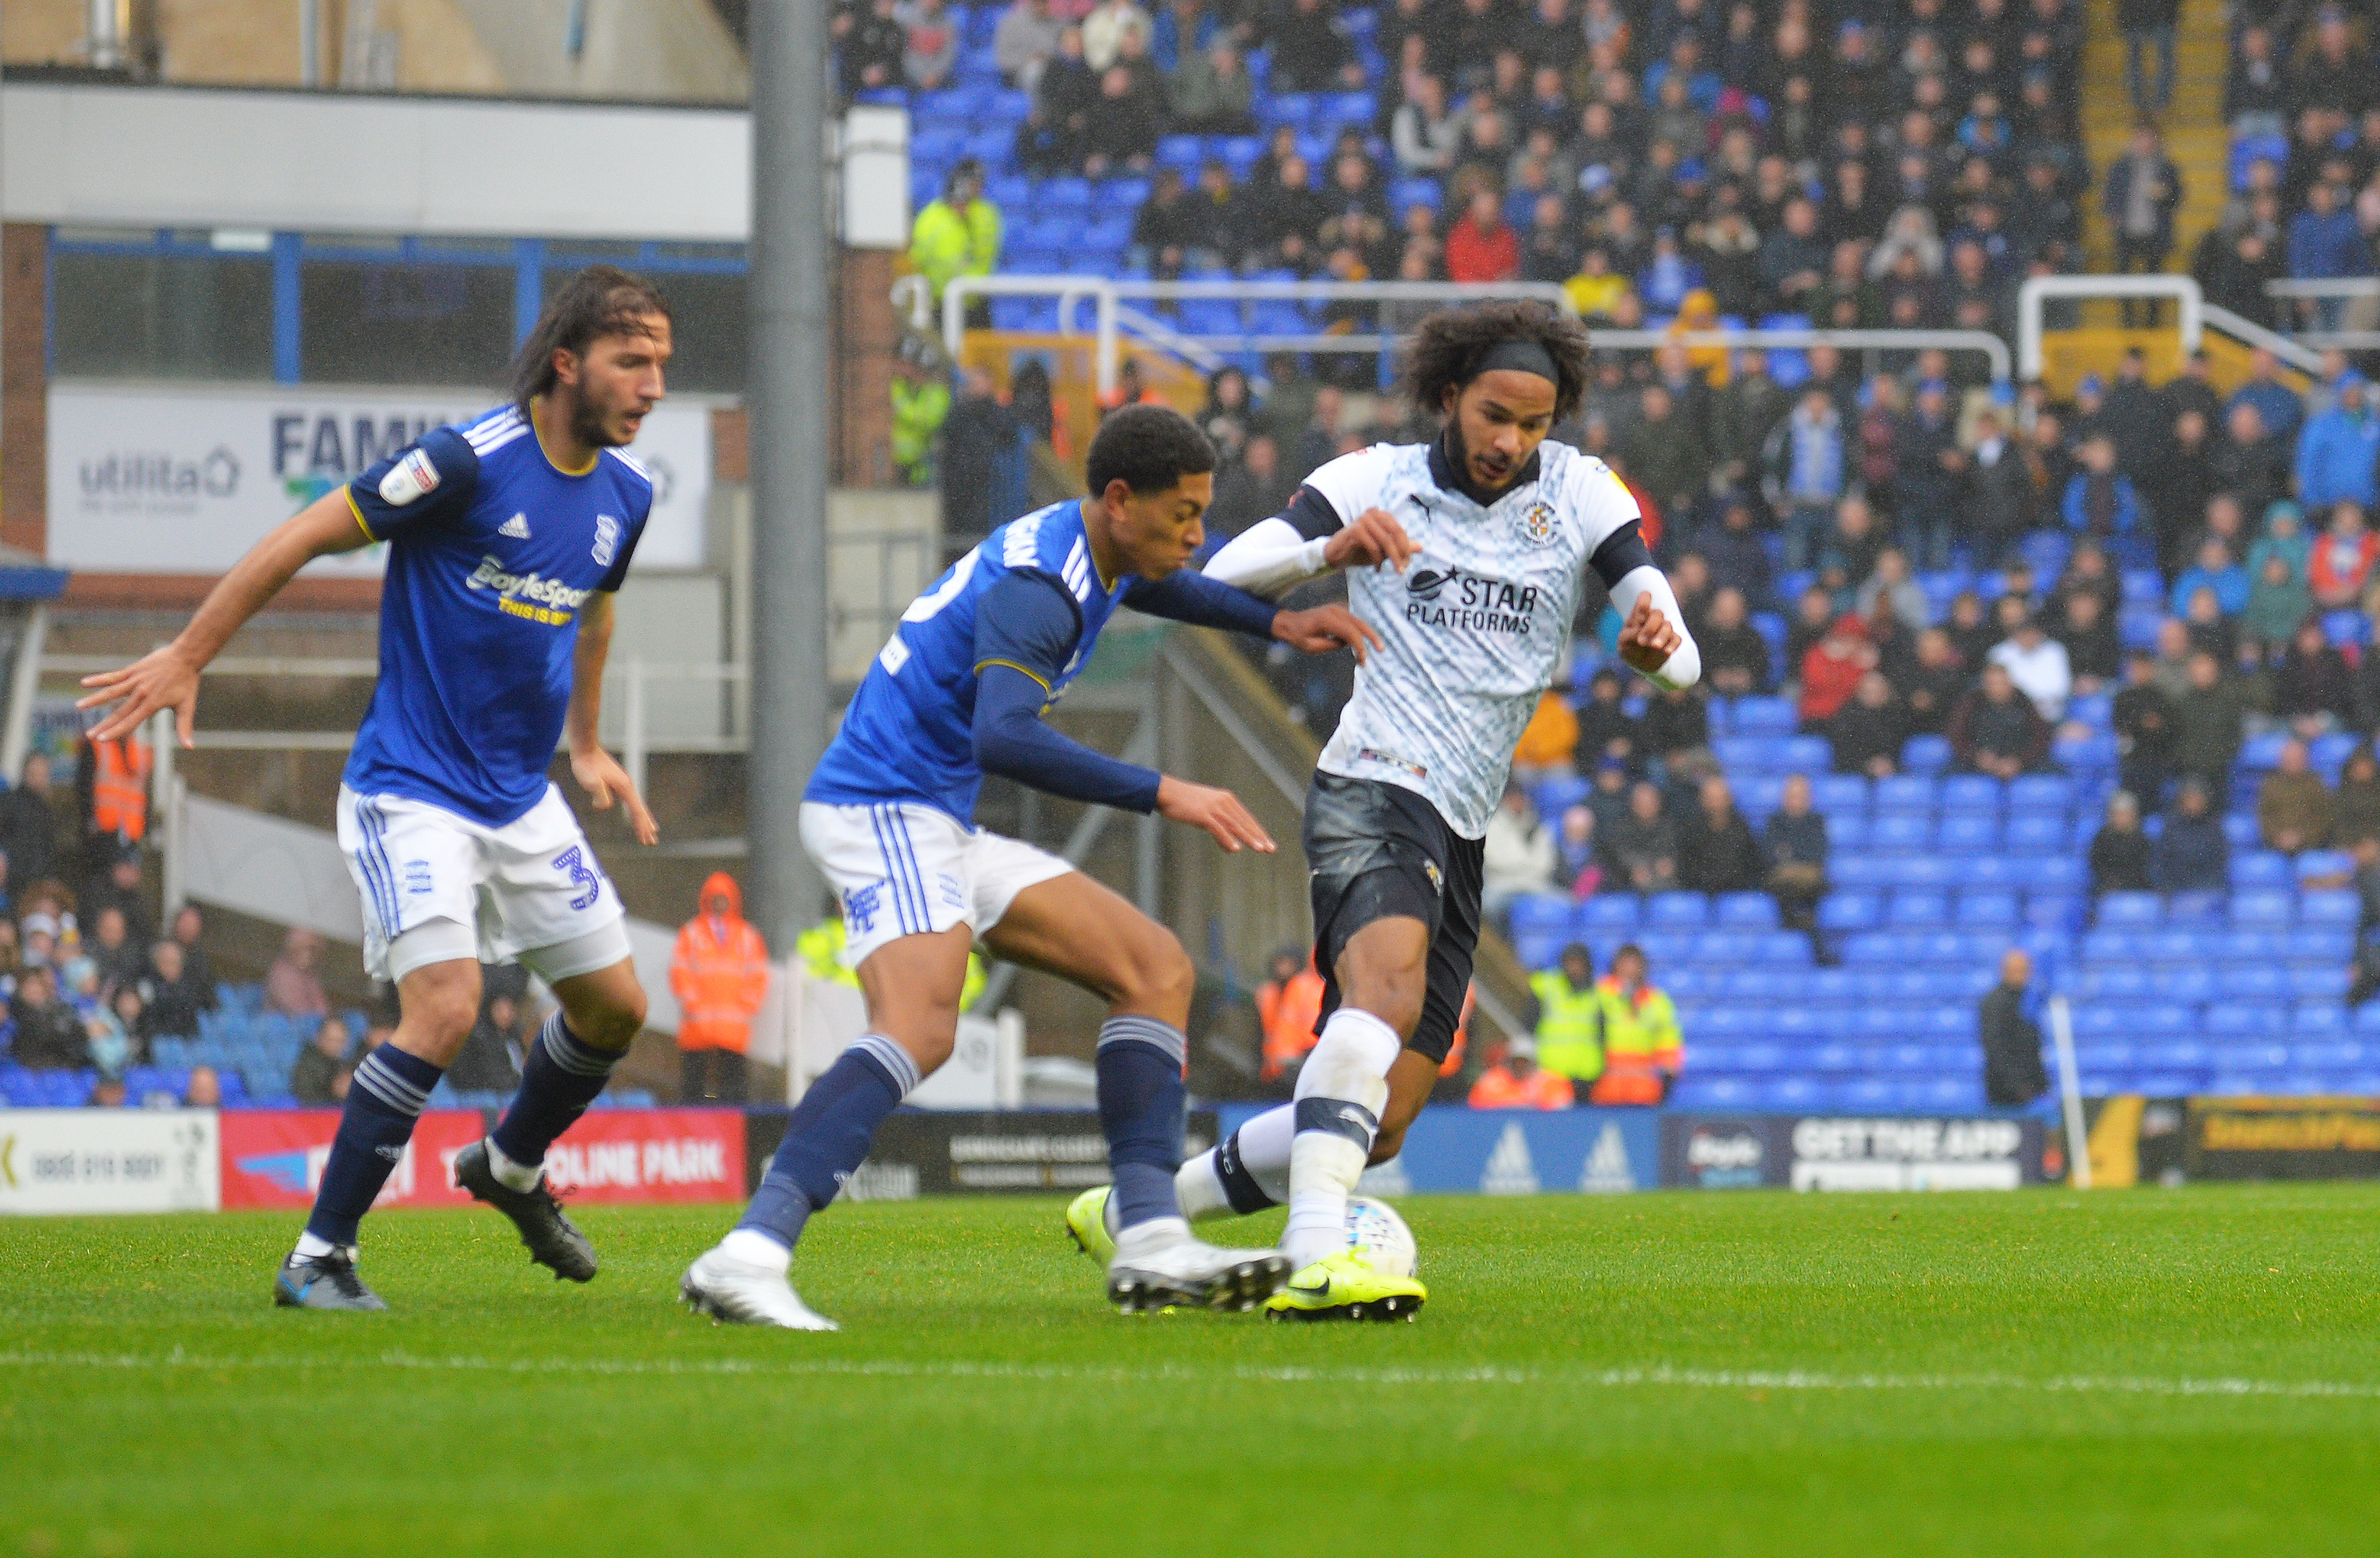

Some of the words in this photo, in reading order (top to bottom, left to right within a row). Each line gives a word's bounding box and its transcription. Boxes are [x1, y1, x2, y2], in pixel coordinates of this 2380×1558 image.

[79, 452, 197, 494] utilita
[499, 597, 534, 620] THIS
[534, 607, 551, 624] IS
[1461, 577, 1537, 613] STAR
[1406, 603, 1532, 634] PLATFORMS
[552, 845, 598, 911] 3
[1792, 1119, 1868, 1160] GET
[1870, 1119, 1941, 1160] THE
[1943, 1119, 2021, 1160] APP
[643, 1138, 725, 1183] PARK
